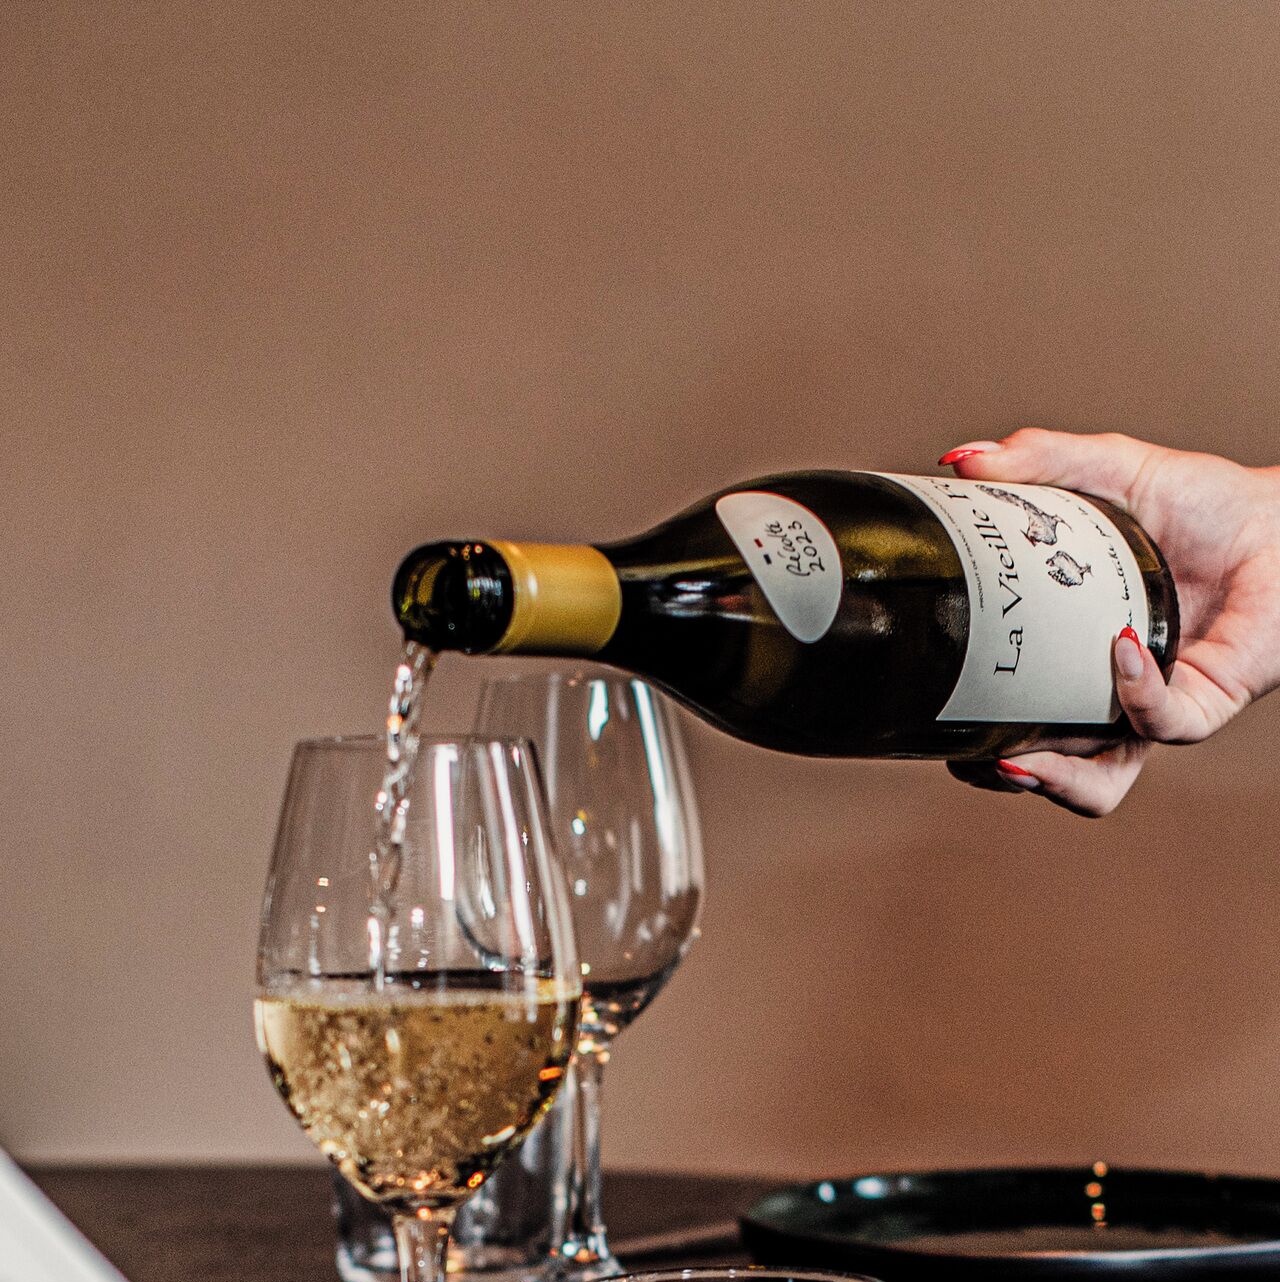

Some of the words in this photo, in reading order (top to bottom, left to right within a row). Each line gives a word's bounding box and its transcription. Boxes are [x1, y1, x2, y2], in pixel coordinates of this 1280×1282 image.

[765, 521, 811, 577] Récolte
[787, 520, 825, 572] 2023
[972, 508, 1023, 619] Vieille
[993, 626, 1023, 676] La
